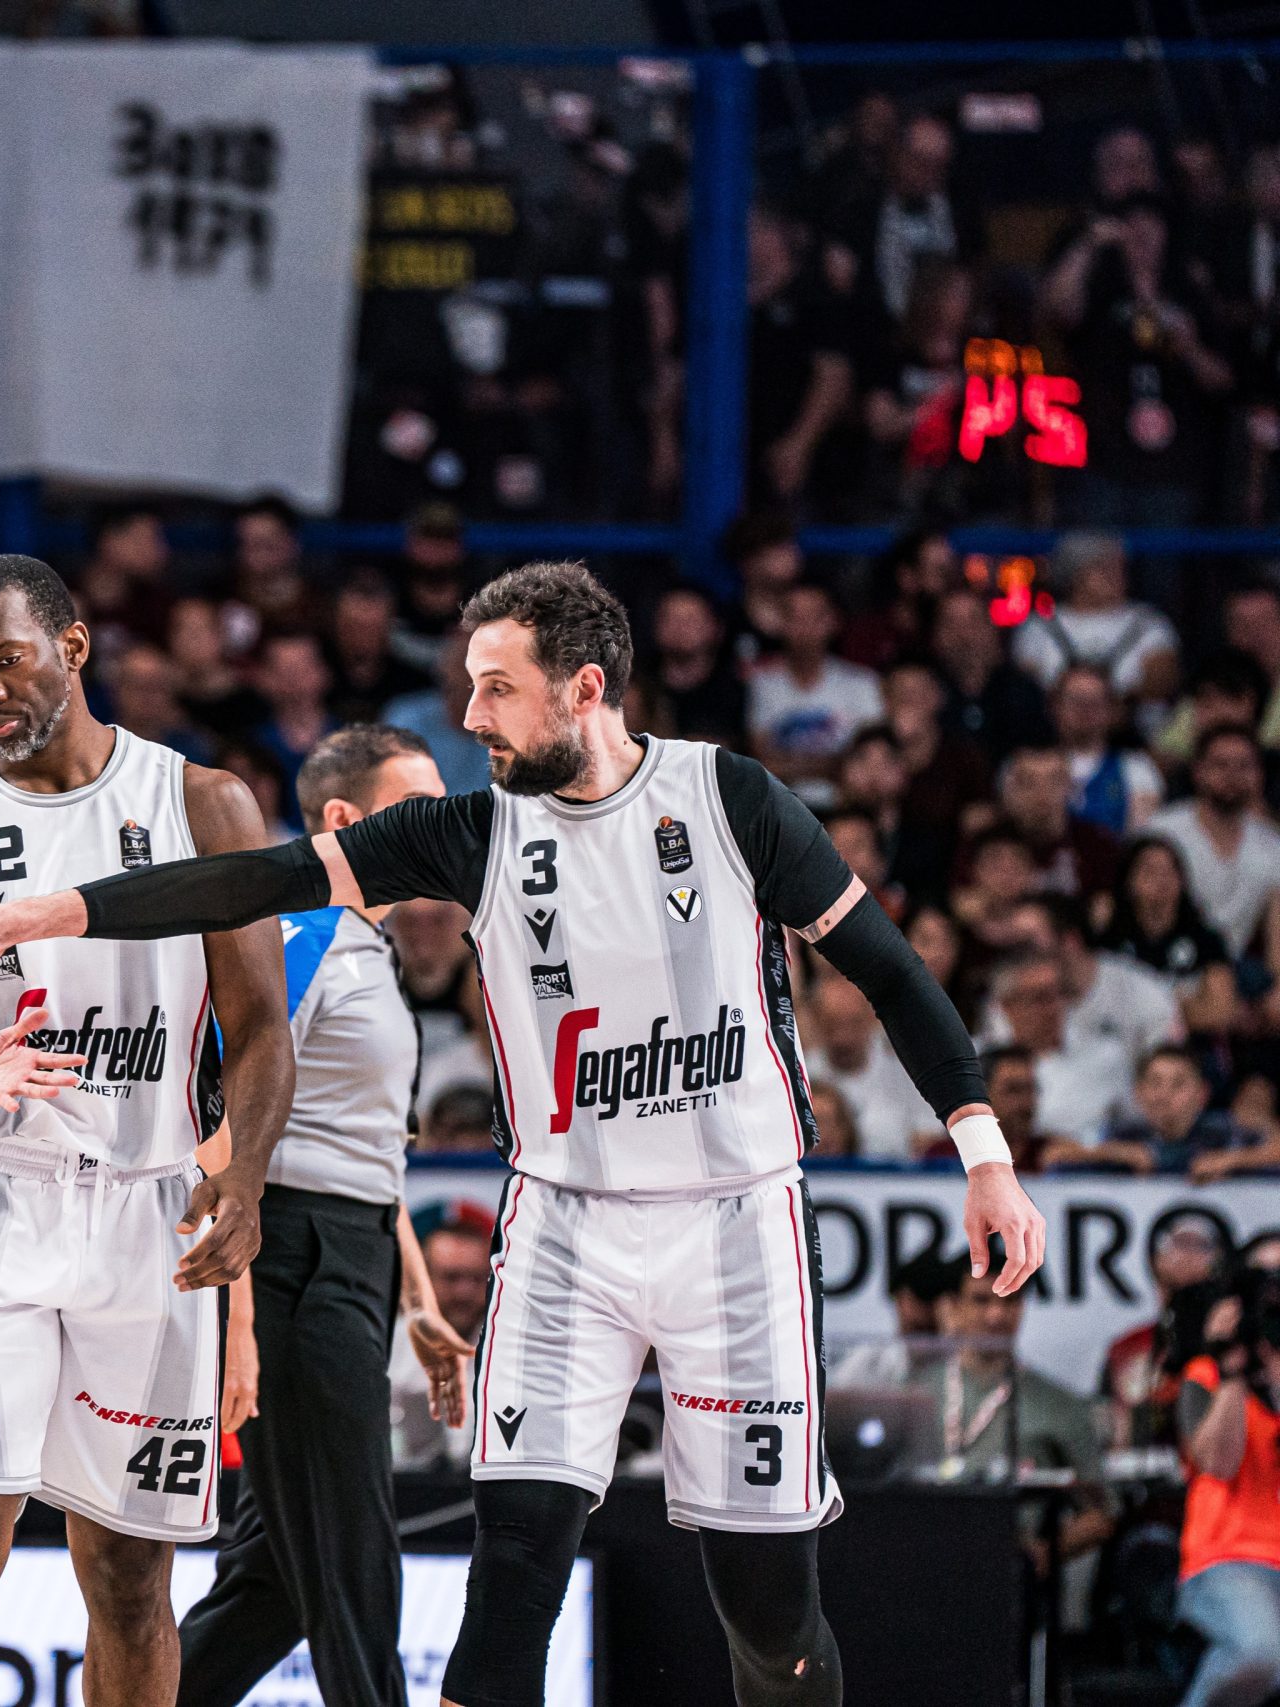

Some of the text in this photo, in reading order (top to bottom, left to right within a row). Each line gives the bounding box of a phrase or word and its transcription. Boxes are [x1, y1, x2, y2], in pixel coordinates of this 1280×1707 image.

[124, 839, 148, 849] LBA
[660, 837, 687, 850] LBA
[521, 838, 559, 896] 3
[532, 972, 566, 986] SPORT
[533, 982, 568, 996] VALLEY
[636, 1091, 717, 1119] ZANETTI
[74, 1391, 214, 1431] PENSKECARS
[126, 1436, 207, 1497] 42
[744, 1424, 783, 1487] 3
